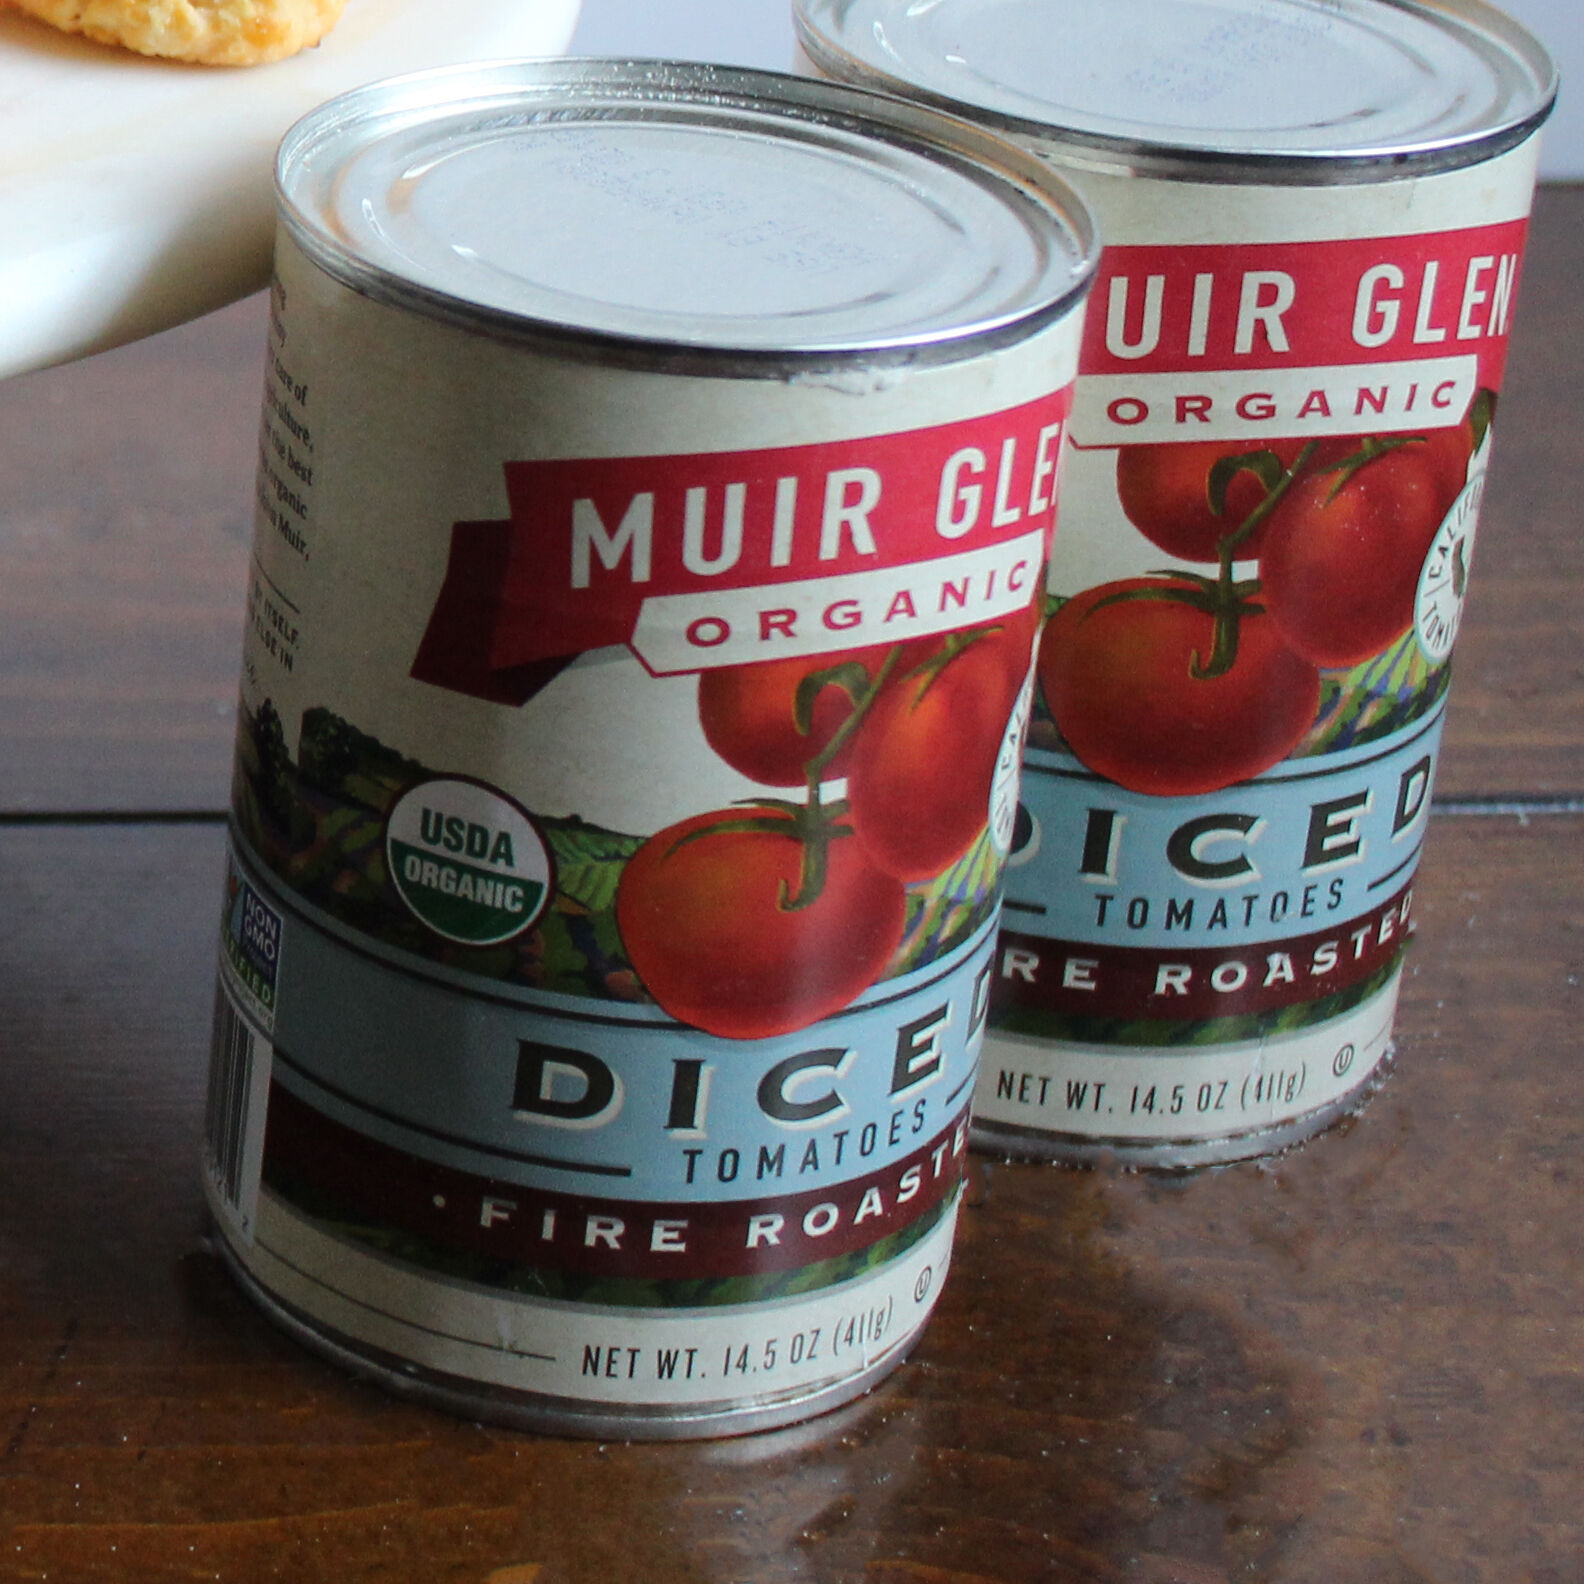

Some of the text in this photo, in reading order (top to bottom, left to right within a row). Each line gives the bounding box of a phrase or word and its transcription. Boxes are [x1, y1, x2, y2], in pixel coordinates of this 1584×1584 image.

[1105, 270, 1297, 360] UIR
[1106, 380, 1456, 426] ORGANIC
[288, 444, 313, 487] best
[571, 419, 1067, 590] MUIR GLE
[278, 513, 310, 563] Muir,
[686, 559, 1029, 649] ORGANIC
[280, 647, 294, 673] IN
[420, 807, 516, 869] USDA
[404, 855, 525, 914] ORGANIC
[1094, 877, 1345, 931] TOMATOES
[243, 916, 276, 961] GMO
[246, 892, 277, 940] NON
[1001, 889, 1414, 996] RE ROASTED
[997, 1061, 1307, 1115] NET WT. 14.5 OZ (411g)
[682, 1097, 927, 1185] TOMATOES
[480, 1106, 971, 1253] FIRE ROASTE
[582, 1294, 894, 1380] NET WT. 14.5 OZ (411g)
